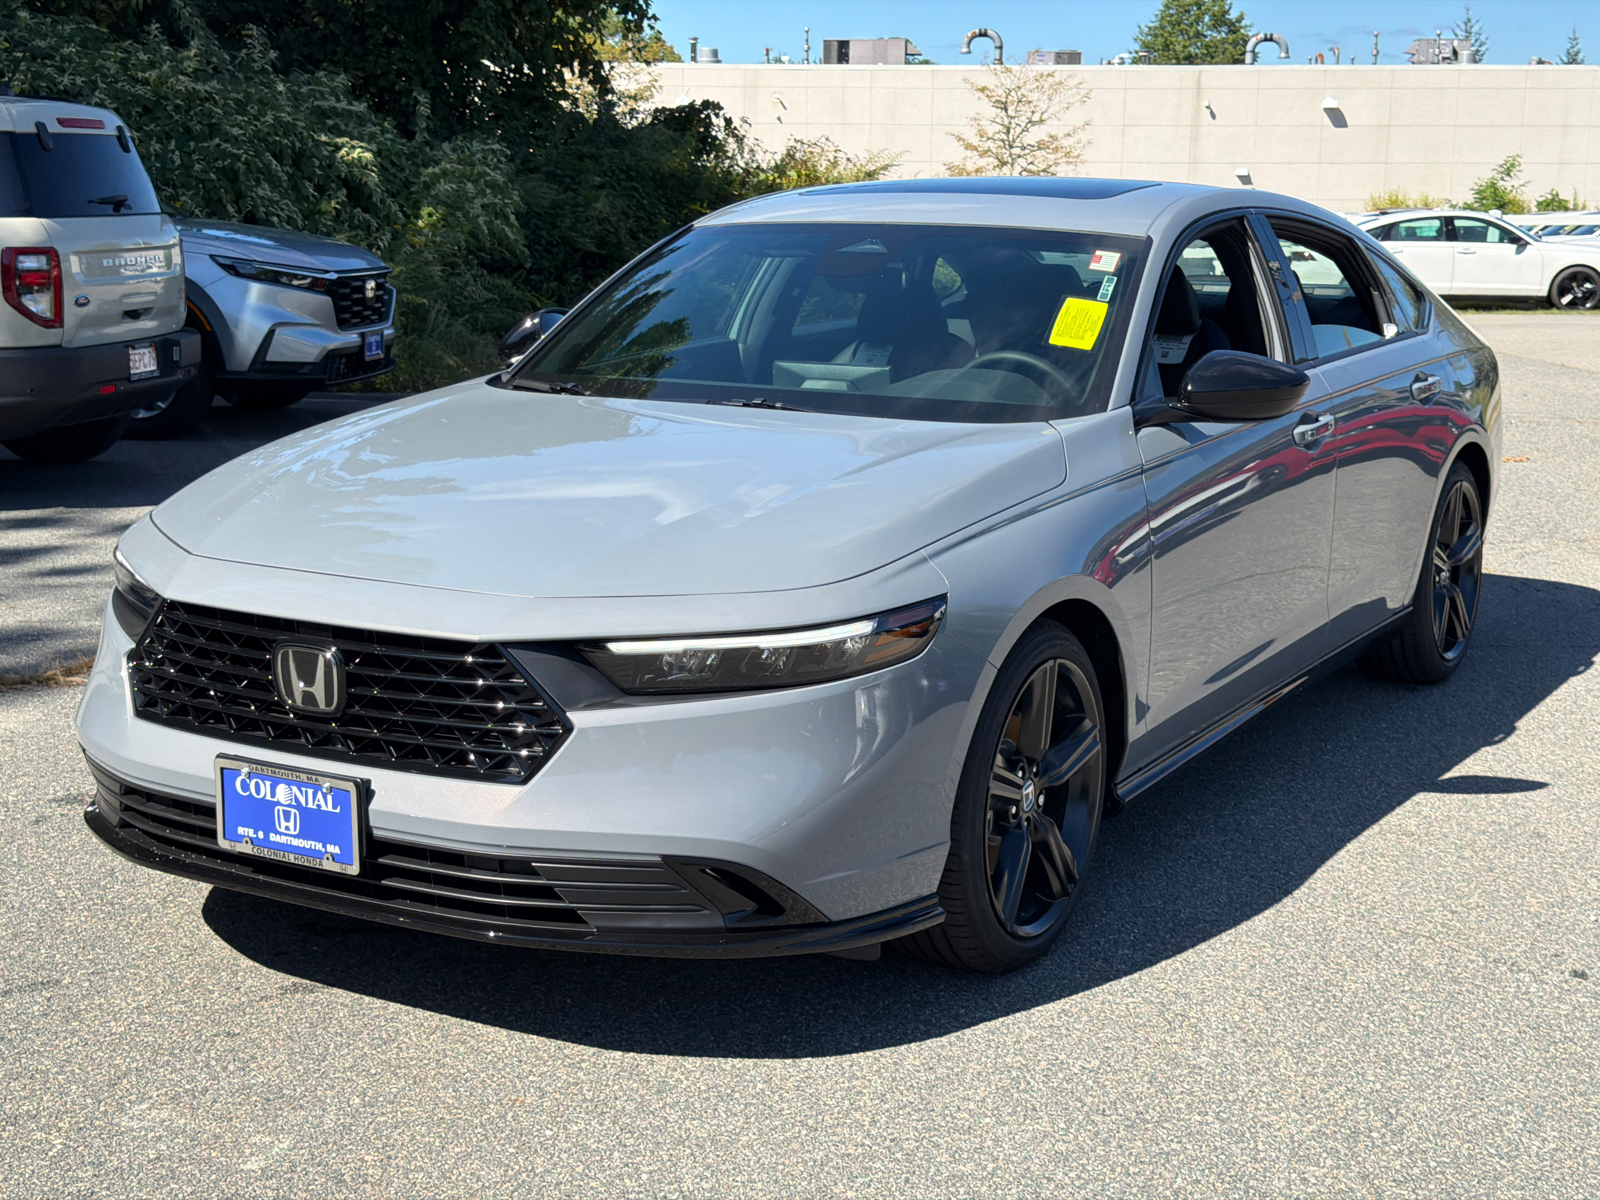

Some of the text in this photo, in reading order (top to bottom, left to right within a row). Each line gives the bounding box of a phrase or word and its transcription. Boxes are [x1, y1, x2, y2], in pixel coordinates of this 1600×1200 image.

[102, 254, 162, 267] BRONCO
[306, 775, 320, 783] MA
[235, 776, 340, 813] COLONIAL
[237, 826, 340, 854] RTE. 6 DARTMOUTH, MA
[251, 846, 323, 867] COLONIAL HONDA
